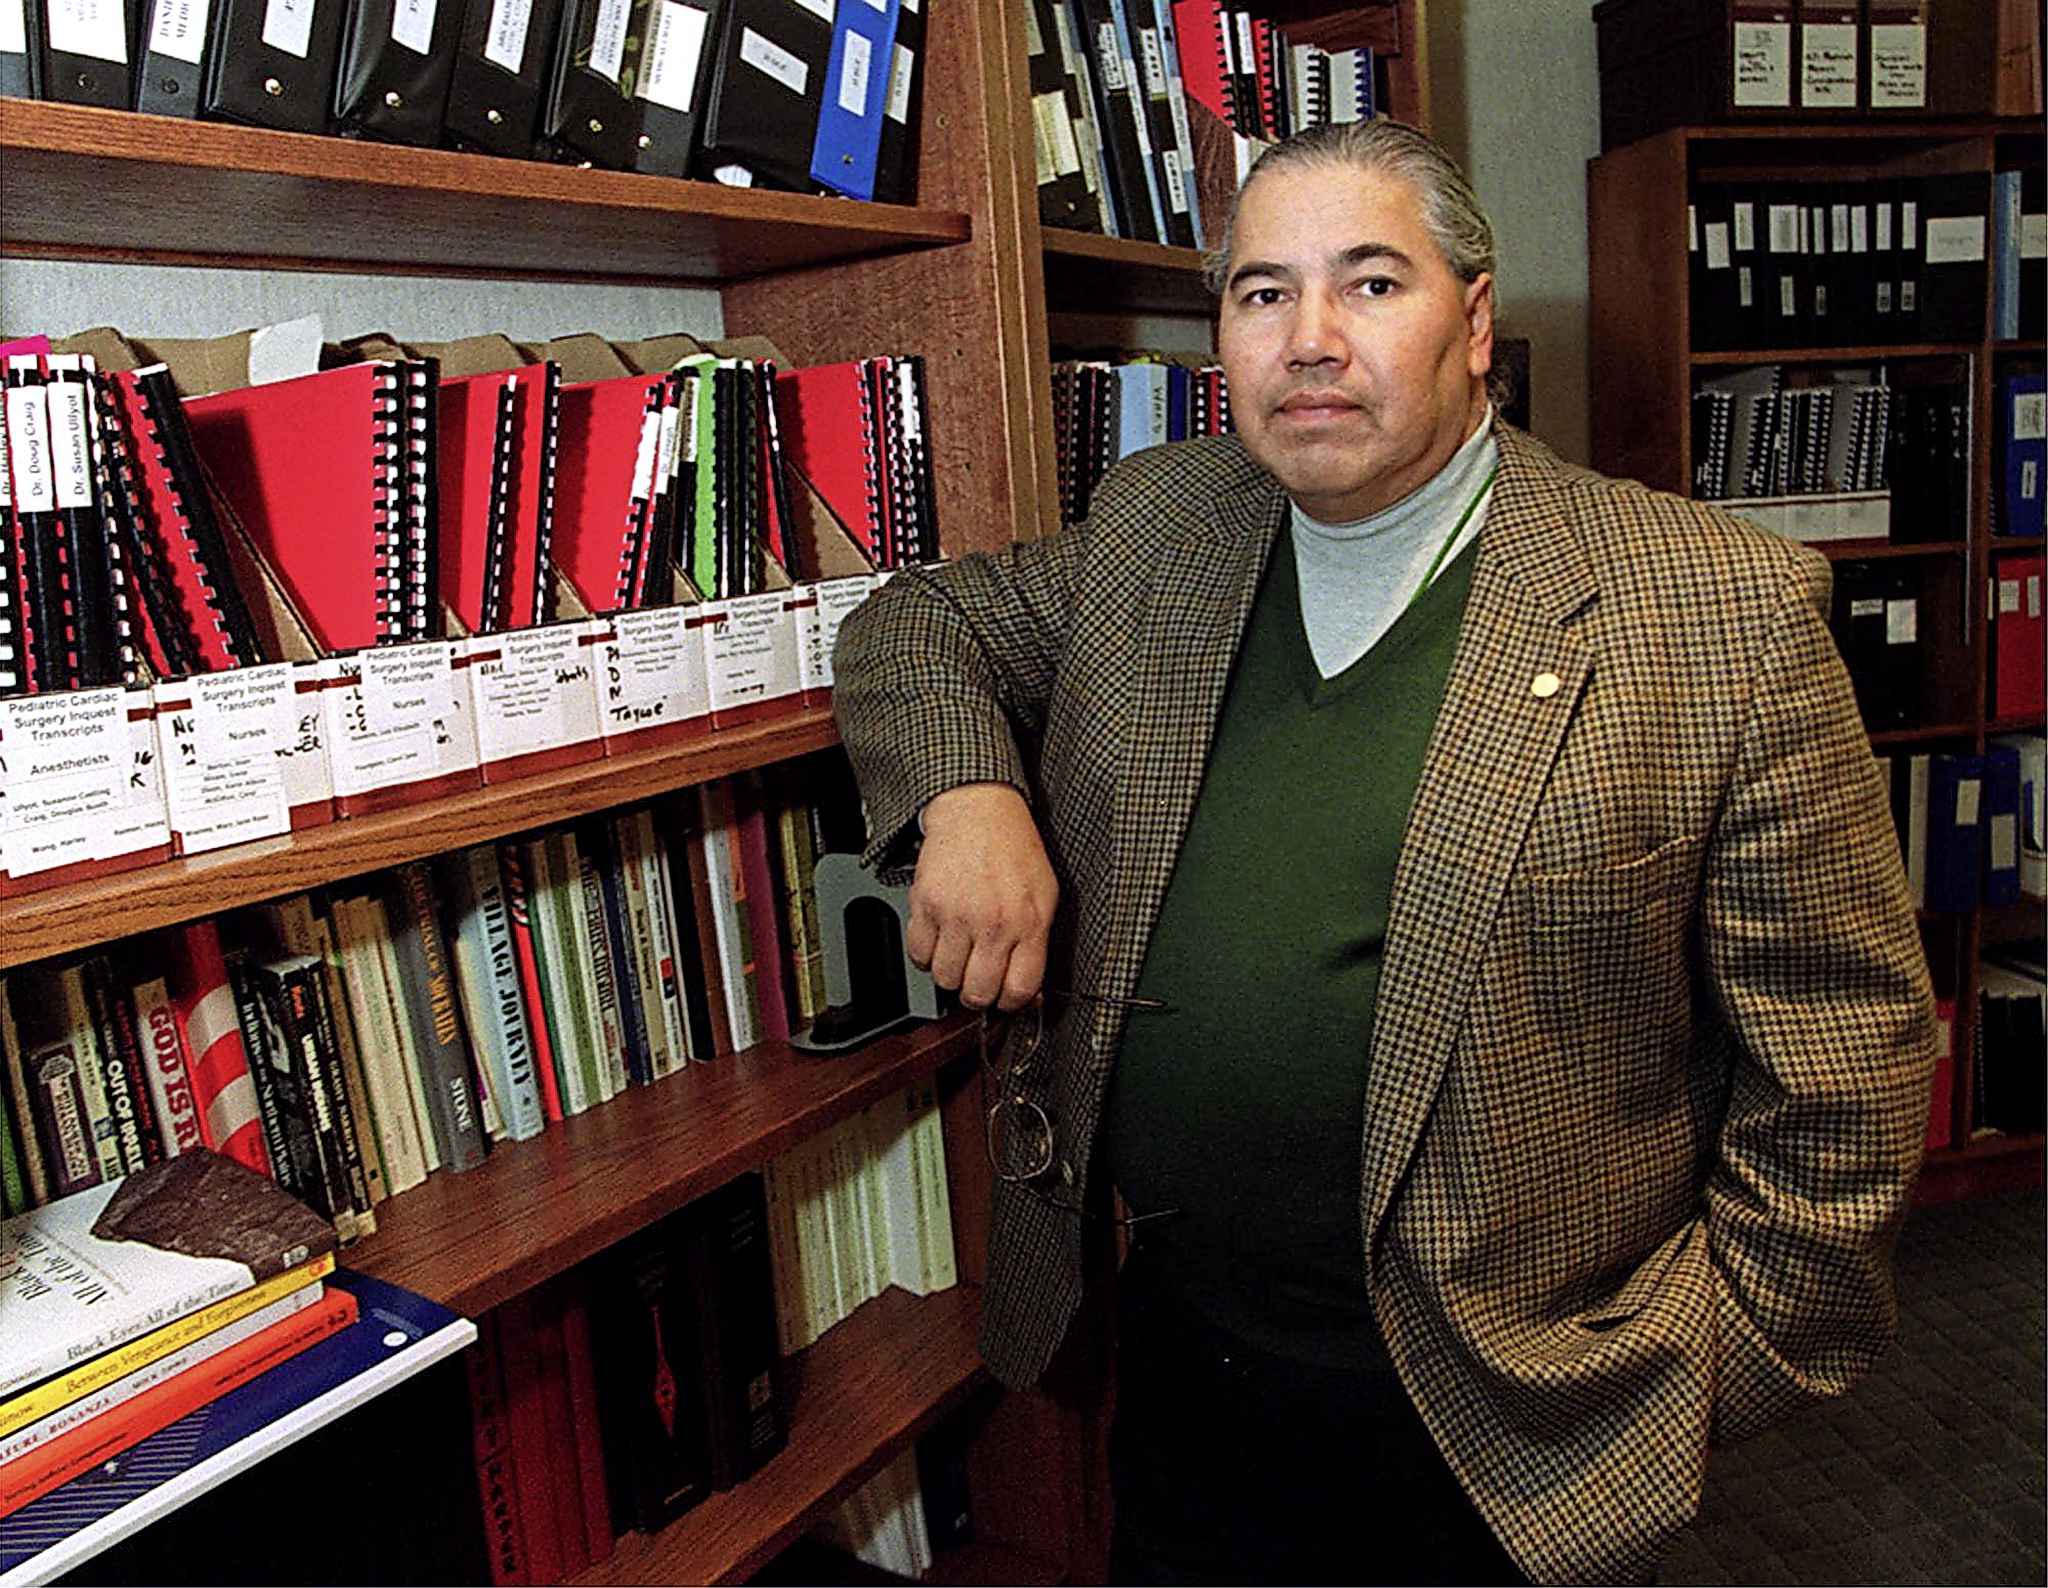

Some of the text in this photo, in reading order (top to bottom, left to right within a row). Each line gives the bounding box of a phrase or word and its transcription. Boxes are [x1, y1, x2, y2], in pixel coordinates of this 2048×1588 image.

[24, 401, 43, 496] Dr. Doug Craig
[72, 435, 84, 474] Susan
[73, 477, 85, 495] Dr.
[366, 646, 443, 660] Pediatric Cardiac
[370, 658, 443, 674] Surgery Inquest
[197, 668, 287, 687] Pediatric Cardiac
[382, 671, 434, 685] Transcripts
[202, 681, 287, 701] Surgery Inquest
[9, 692, 119, 713] Pediatric Cardiac
[216, 696, 276, 712] Transcripts
[393, 698, 426, 708] Nurses
[14, 707, 117, 729] Surgery Inquest
[31, 724, 105, 741] Transcripts
[228, 728, 267, 740] Nurses
[30, 754, 111, 775] Anesthetists
[482, 886, 531, 1086] VILLAGE JOURNEY
[150, 1005, 181, 1076] GOD
[107, 1059, 130, 1095] OUT
[301, 1033, 332, 1132] URBAN INDIANS
[114, 1095, 133, 1121] OF
[164, 1081, 190, 1113] IS
[448, 1077, 473, 1133] STONE
[67, 1333, 105, 1361] Black
[109, 1323, 141, 1343] Eyes
[147, 1308, 164, 1324] All
[166, 1301, 182, 1317] of
[184, 1294, 206, 1310] the
[208, 1280, 239, 1299] Time
[66, 1363, 119, 1392] Between
[121, 1334, 180, 1364] Vengeance
[184, 1315, 204, 1335] and
[49, 1397, 110, 1434] BONANZA
